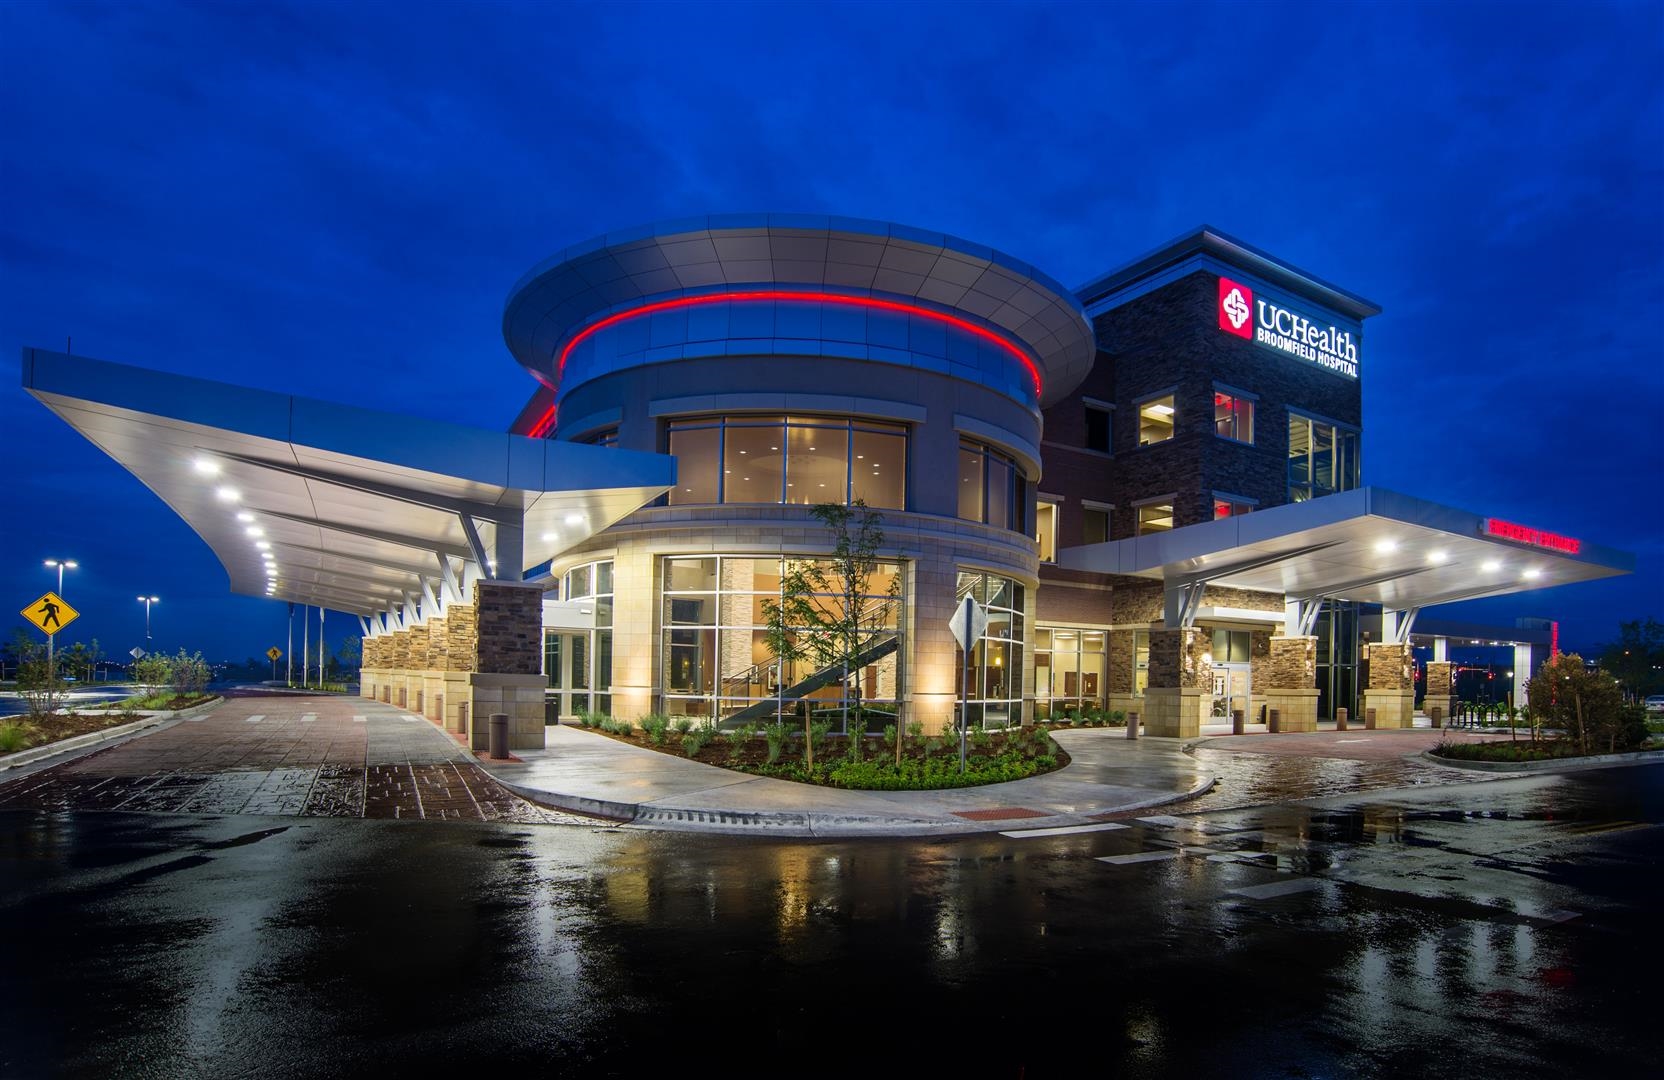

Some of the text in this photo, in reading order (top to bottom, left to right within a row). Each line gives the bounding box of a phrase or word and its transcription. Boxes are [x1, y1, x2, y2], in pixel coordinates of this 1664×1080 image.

[1257, 299, 1358, 364] UCHealth
[1257, 327, 1358, 378] BROOMFIELD HOSPITAL
